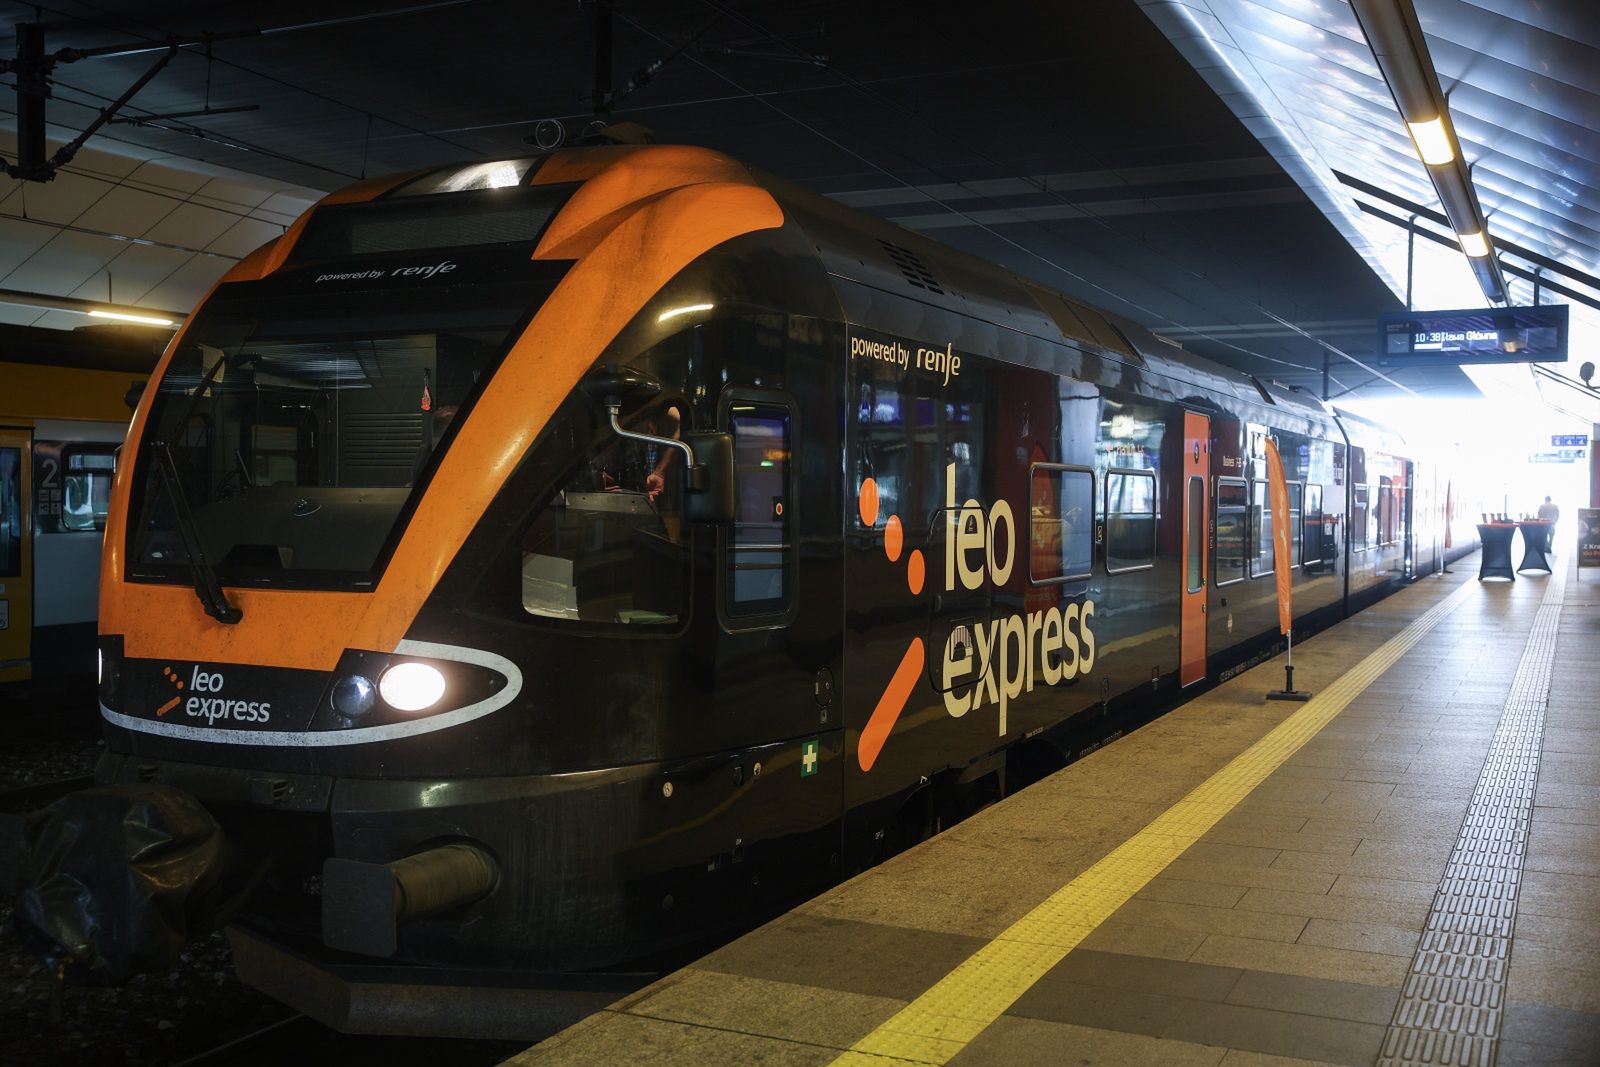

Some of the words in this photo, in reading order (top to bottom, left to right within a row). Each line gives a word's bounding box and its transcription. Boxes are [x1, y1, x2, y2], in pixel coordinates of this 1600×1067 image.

[315, 270, 370, 283] powered
[368, 270, 386, 279] by
[391, 260, 457, 280] renfe
[1415, 333, 1441, 343] 10:38
[851, 336, 896, 363] powered
[897, 342, 910, 371] by
[916, 342, 961, 387] renfe
[41, 458, 58, 488] 2
[945, 461, 1016, 591] leo
[190, 664, 224, 693] leo
[942, 599, 1095, 737] express
[186, 696, 271, 726] express
